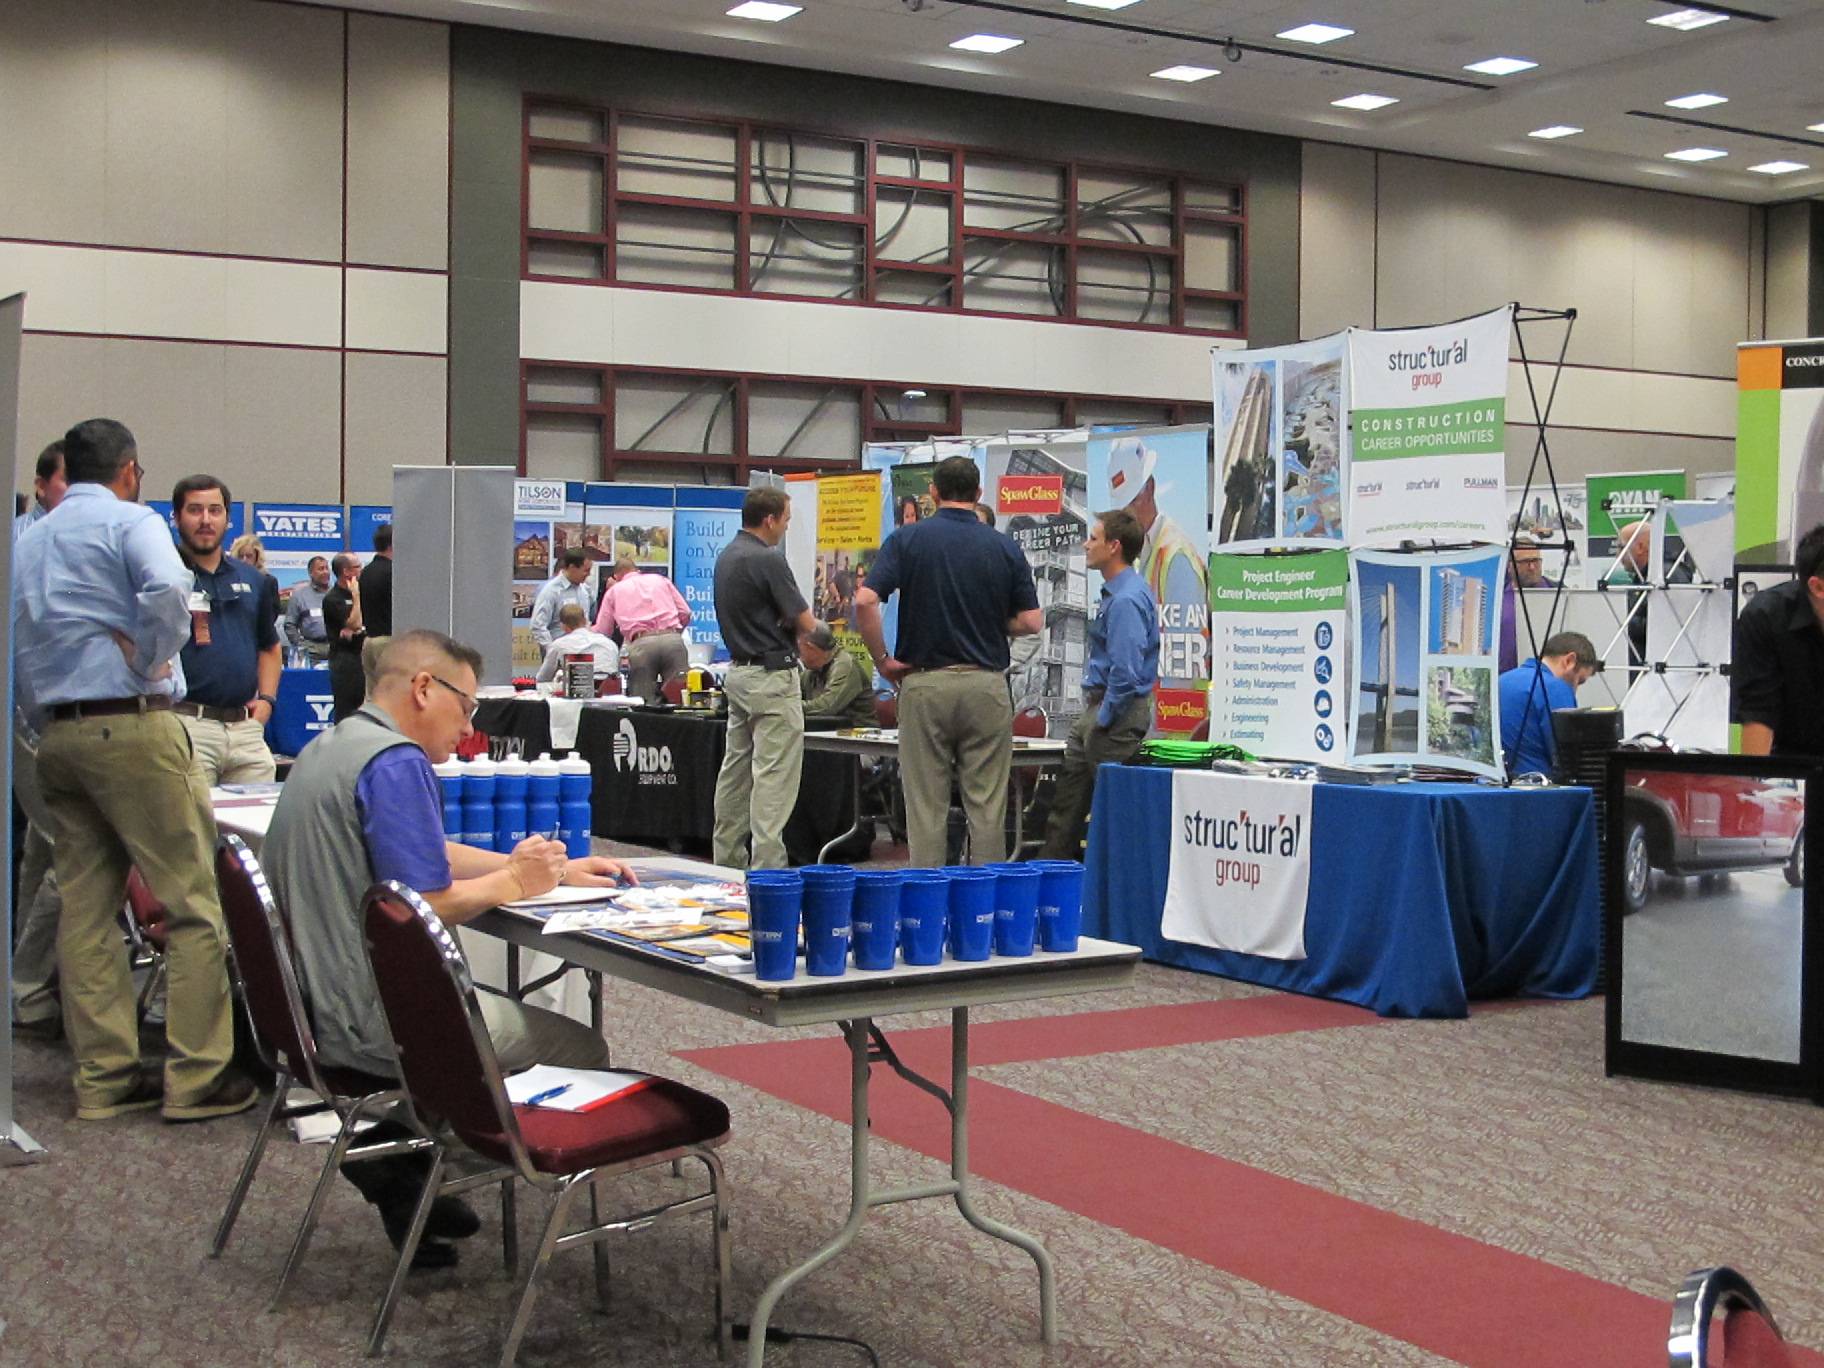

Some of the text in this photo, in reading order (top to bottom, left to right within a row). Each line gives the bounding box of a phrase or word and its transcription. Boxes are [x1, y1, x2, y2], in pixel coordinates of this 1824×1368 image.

[1412, 372, 1442, 390] group
[1361, 409, 1495, 432] CONSTRUCTION
[1361, 429, 1494, 450] CAREER OPPORTUNITIES
[519, 486, 562, 499] TILSON
[1001, 486, 1059, 504] SpawGlass
[260, 515, 338, 533] YATES
[686, 521, 725, 537] Build
[1013, 524, 1079, 540] DEFINE YOUR
[686, 542, 724, 558] on Yo
[1021, 538, 1051, 549] AREER
[686, 564, 714, 578] Lan
[1243, 570, 1315, 585] Project Engineer
[686, 585, 711, 600] Bui
[1217, 585, 1343, 603] Career Development Program
[1158, 604, 1208, 628] KE AN
[688, 626, 722, 642] Trus
[1233, 626, 1298, 639] Project Management
[1263, 645, 1305, 656] Management
[1233, 662, 1304, 673] Business Development
[1233, 679, 1296, 691] Safety Management
[1232, 696, 1278, 705] Administration
[1231, 712, 1269, 725] Engineering
[638, 746, 672, 772] RDO
[1216, 858, 1261, 890] group
